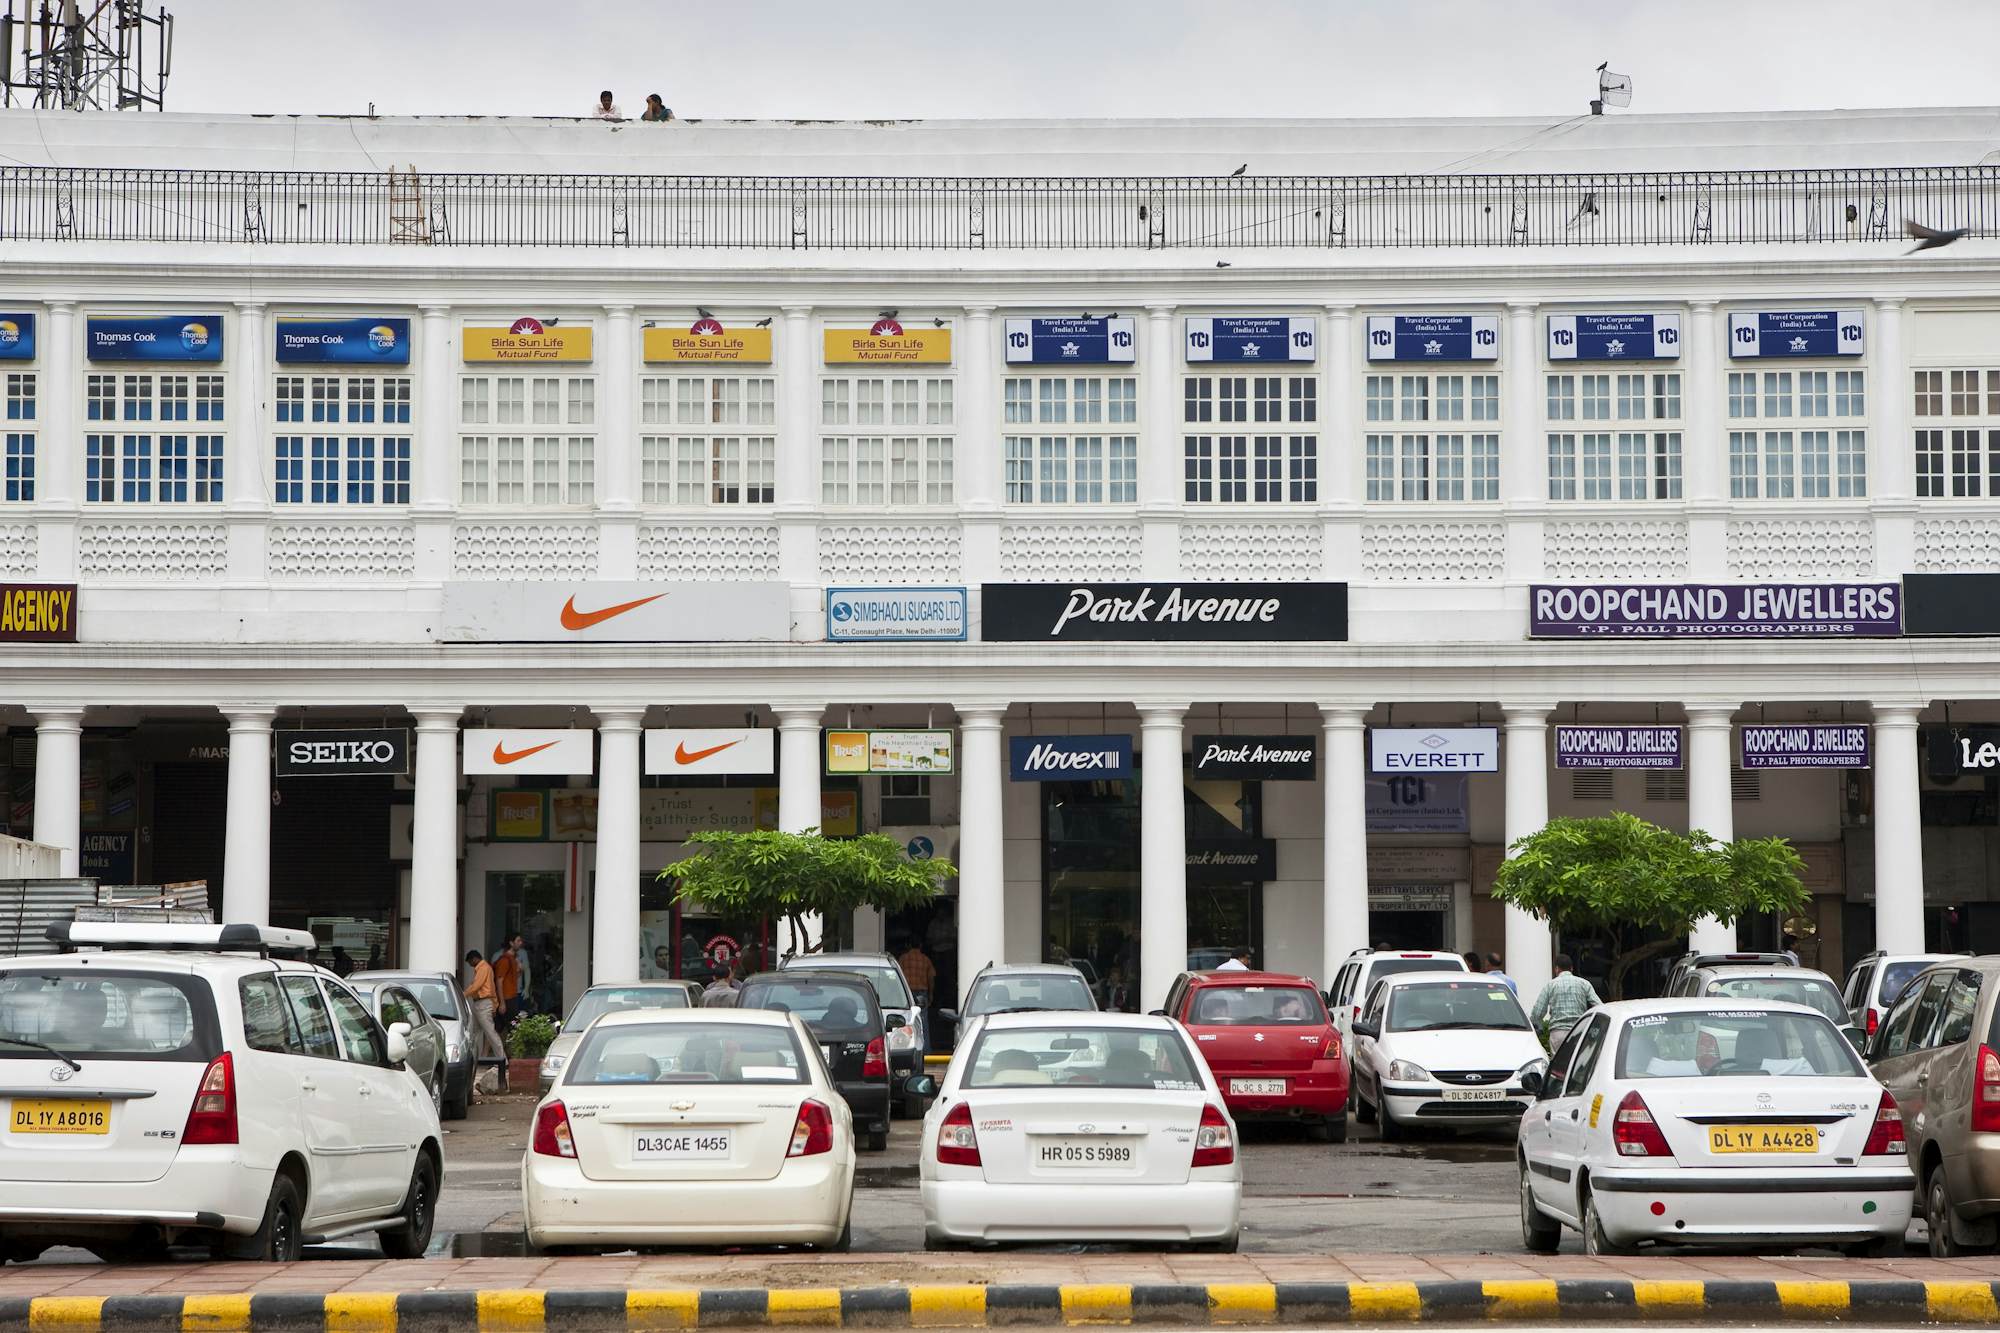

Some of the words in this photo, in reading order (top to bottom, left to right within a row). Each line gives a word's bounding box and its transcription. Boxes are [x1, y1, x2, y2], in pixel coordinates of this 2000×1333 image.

[1061, 319, 1099, 327] Corporation
[1242, 319, 1280, 327] Corporation
[1789, 313, 1828, 321] Corporation
[1597, 323, 1618, 331] (India)
[1619, 323, 1633, 331] Ltd.
[1841, 325, 1861, 341] TCI
[95, 332, 131, 342] Thomas
[133, 333, 156, 342] Cook
[181, 331, 208, 339] Thomas
[284, 334, 319, 344] Thomas
[321, 335, 344, 344] Cook
[368, 333, 394, 341] Thomas
[1009, 332, 1028, 348] TCI
[1112, 331, 1132, 347] TCI
[1190, 332, 1209, 348] TCI
[1293, 331, 1312, 348] TCI
[1372, 330, 1391, 345] TCI
[1476, 329, 1495, 345] TCI
[1553, 329, 1573, 345] TCI
[1658, 328, 1677, 344] TCI
[1735, 326, 1755, 343] TCI
[378, 340, 395, 348] Cook
[491, 338, 515, 347] Birla
[519, 338, 540, 347] Sun
[543, 338, 564, 347] Life
[672, 339, 695, 348] Birla
[699, 339, 721, 348] Sun
[723, 339, 744, 348] Life
[852, 339, 875, 348] Birla
[879, 339, 901, 348] Sun
[903, 339, 923, 348] Life
[496, 351, 532, 359] Mutual
[534, 351, 558, 359] Fund
[678, 351, 712, 359] Mutual
[714, 351, 738, 359] Fund
[857, 352, 892, 360] Mutual
[894, 352, 918, 360] Fund
[1, 589, 72, 632] AGENCY
[1537, 588, 1728, 621] ROOPCHAND
[1737, 587, 1895, 621] JEWELLERS
[853, 601, 907, 622] SIMBHAOLI
[908, 601, 944, 621] SUGARS
[945, 601, 961, 621] LTD
[1051, 588, 1156, 635] Park
[1154, 588, 1280, 622] Avenue
[851, 628, 885, 636] Connaught
[1578, 625, 1614, 633] T.P.
[1622, 625, 1670, 633] PALL
[1676, 624, 1856, 633] PHOTOGRAPHERS
[1560, 730, 1623, 752] ROOPCHAND
[1626, 730, 1677, 752] JEWELLERS
[1745, 729, 1810, 752] ROOPCHAND
[1812, 728, 1865, 751] JEWELLERS
[290, 740, 395, 763] SEIKO
[832, 744, 864, 757] TRUST
[1024, 743, 1105, 771] Novex
[1198, 744, 1250, 769] Park
[1249, 744, 1312, 763] Avenue
[1960, 737, 2000, 768] Le
[1386, 753, 1485, 767] EVERETT
[1565, 758, 1580, 766] T.P.
[1583, 758, 1602, 766] PALL
[1603, 757, 1674, 766] PHOTOGRAPHERS
[1751, 757, 1766, 765] T.P.
[1768, 757, 1788, 765] PALL
[1790, 756, 1861, 765] PHOTOGRAPHERS
[1387, 775, 1425, 805] TCI
[659, 798, 692, 809] Trust
[710, 813, 753, 826] Sugar
[83, 835, 128, 852] AGENCY
[83, 855, 109, 867] Books
[1185, 851, 1210, 865] ark
[1211, 851, 1258, 865] Avenue
[16, 1111, 34, 1125] DL
[39, 1111, 54, 1125] 1Y
[58, 1111, 104, 1126] A8016
[694, 1137, 727, 1151] 1455
[1714, 1133, 1733, 1147] DL
[1738, 1133, 1753, 1147] 1Y
[1762, 1132, 1814, 1147] A4428
[1042, 1147, 1062, 1160] HR
[1066, 1147, 1082, 1160] 05
[1085, 1147, 1095, 1160] S
[1098, 1147, 1130, 1161] 5989
